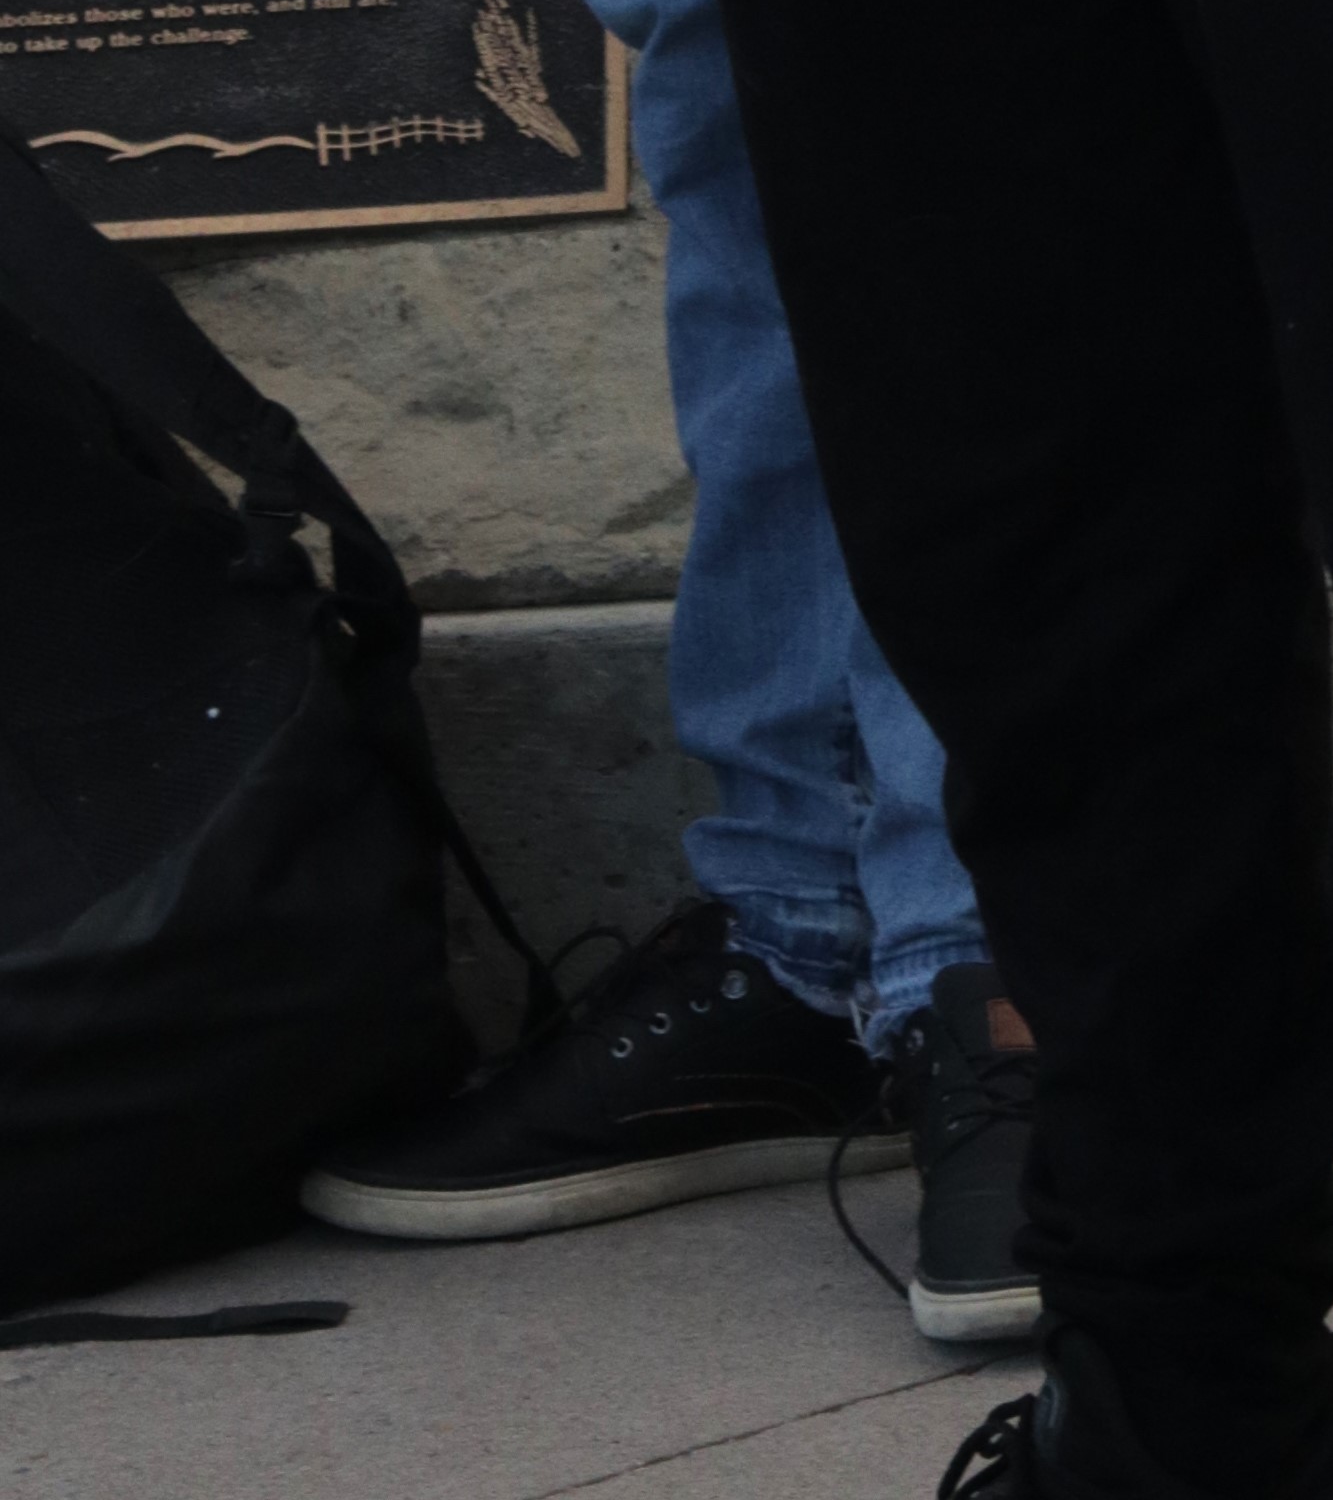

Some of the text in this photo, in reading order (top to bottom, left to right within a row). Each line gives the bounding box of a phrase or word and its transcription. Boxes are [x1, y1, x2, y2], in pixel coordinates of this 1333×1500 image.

[84, 7, 143, 23] those
[151, 3, 195, 19] who
[24, 35, 69, 52] take
[76, 36, 103, 53] up
[109, 31, 143, 48] the
